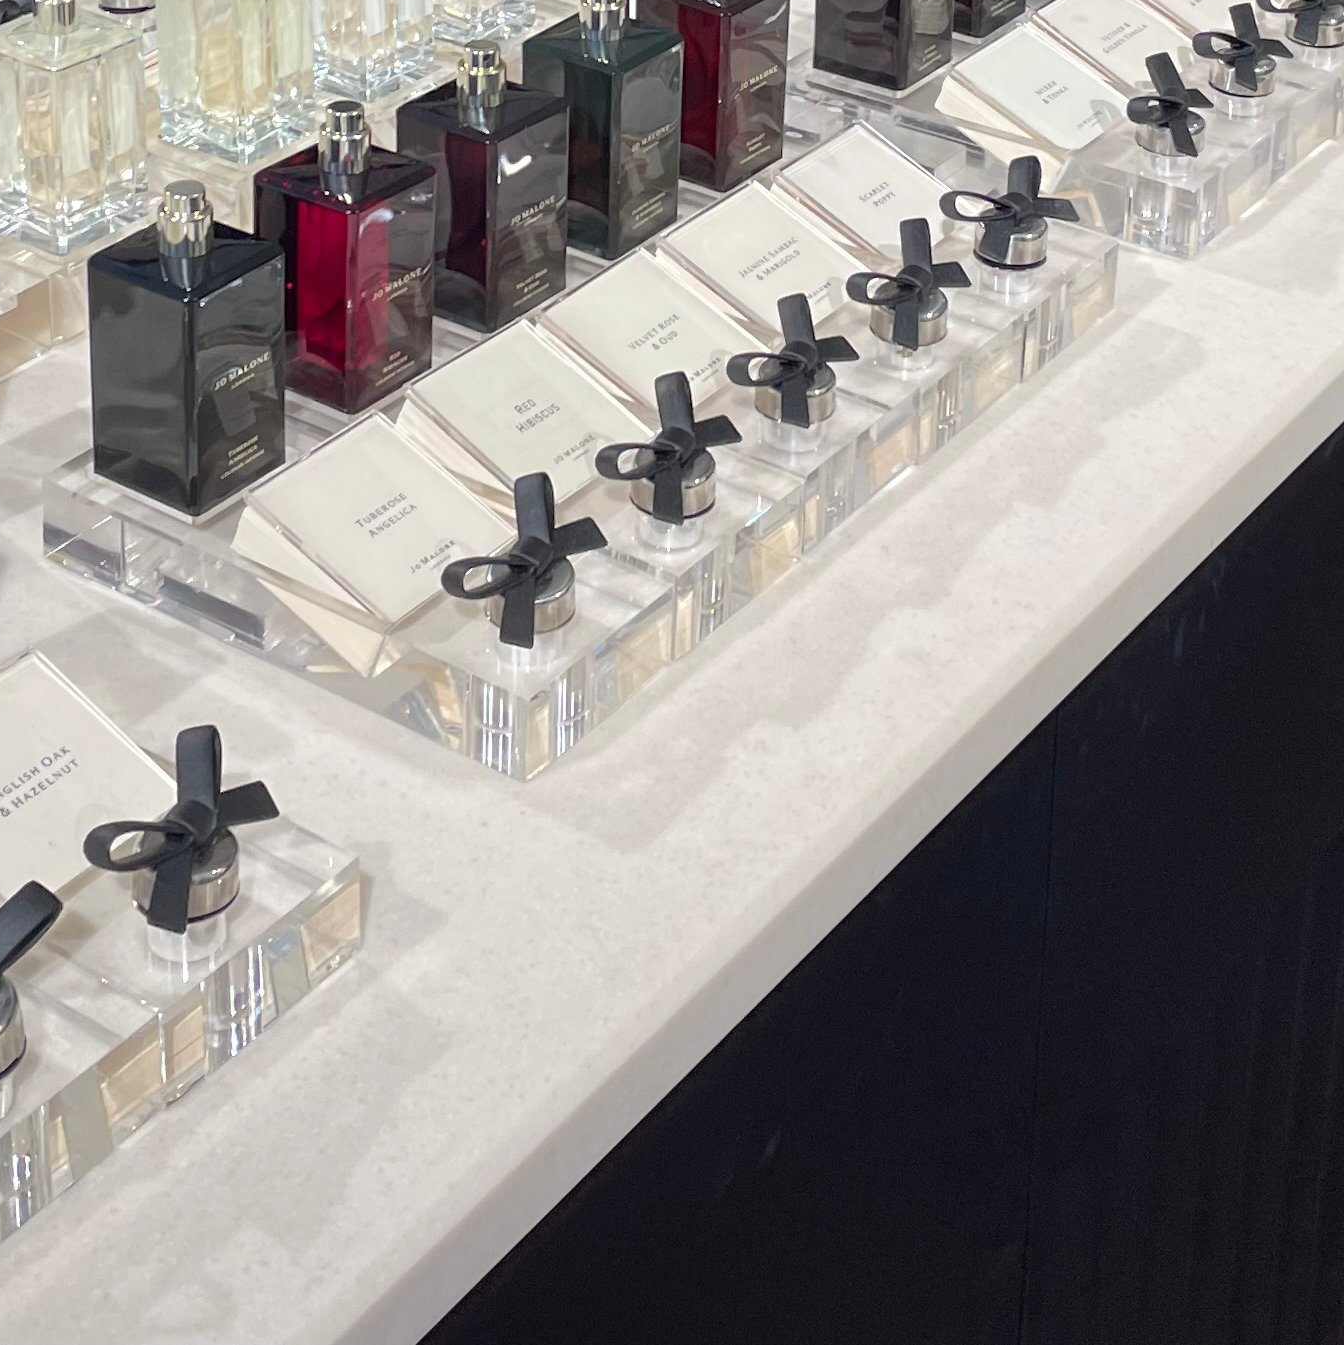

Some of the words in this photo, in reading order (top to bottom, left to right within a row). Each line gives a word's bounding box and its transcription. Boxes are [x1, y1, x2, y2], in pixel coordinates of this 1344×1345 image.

[627, 328, 658, 350] VELVET
[657, 313, 681, 330] ROSE
[214, 377, 227, 391] JO
[228, 352, 271, 382] MALONE
[514, 399, 536, 415] RED
[516, 403, 561, 433] HIBISCUS
[354, 492, 407, 528] TUBEROSE
[368, 504, 417, 538] ANGELICA
[40, 745, 71, 767] OAK
[0, 807, 11, 818] &
[11, 758, 79, 809] HAZELNUT
